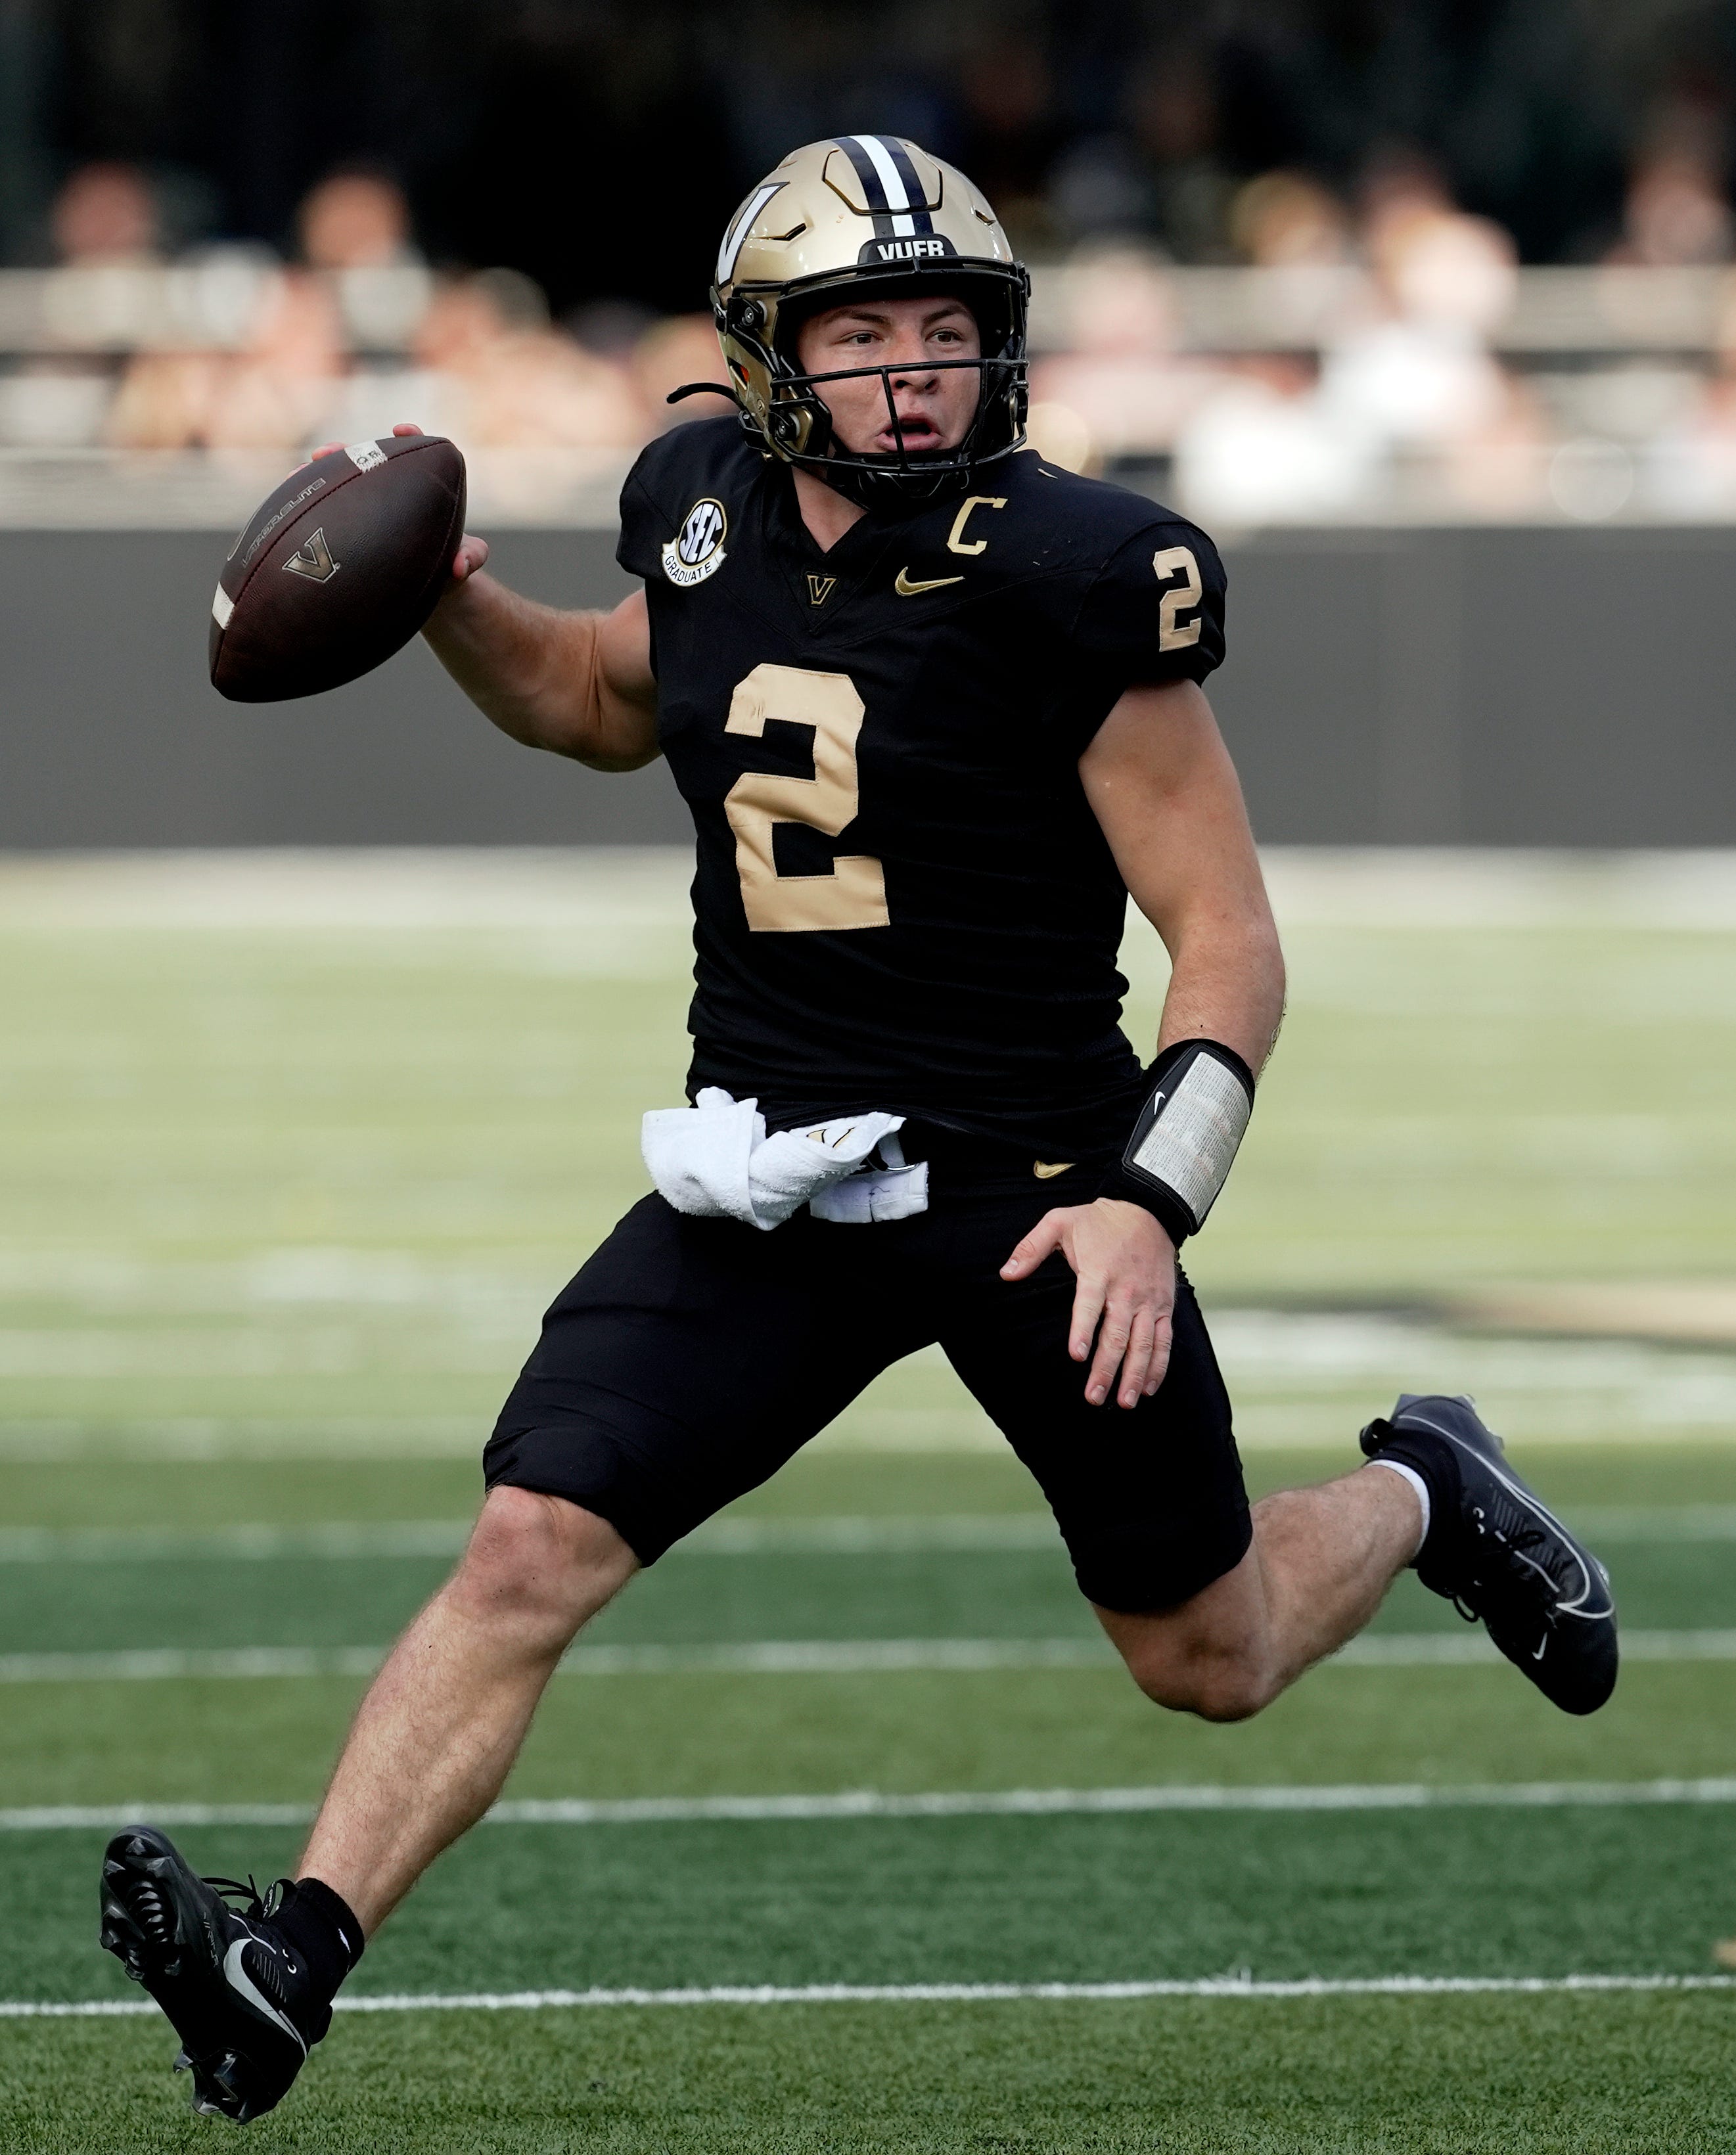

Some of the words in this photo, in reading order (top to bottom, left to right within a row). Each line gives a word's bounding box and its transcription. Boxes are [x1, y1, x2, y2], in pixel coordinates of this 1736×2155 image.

[877, 240, 945, 261] VUFB
[280, 478, 326, 518] ELITE
[947, 495, 1008, 555] C
[282, 527, 337, 583] V
[679, 503, 723, 563] SEC
[665, 555, 712, 583] GRADUATE
[806, 574, 837, 605] V
[1153, 546, 1202, 652] 2
[723, 663, 891, 932] 2
